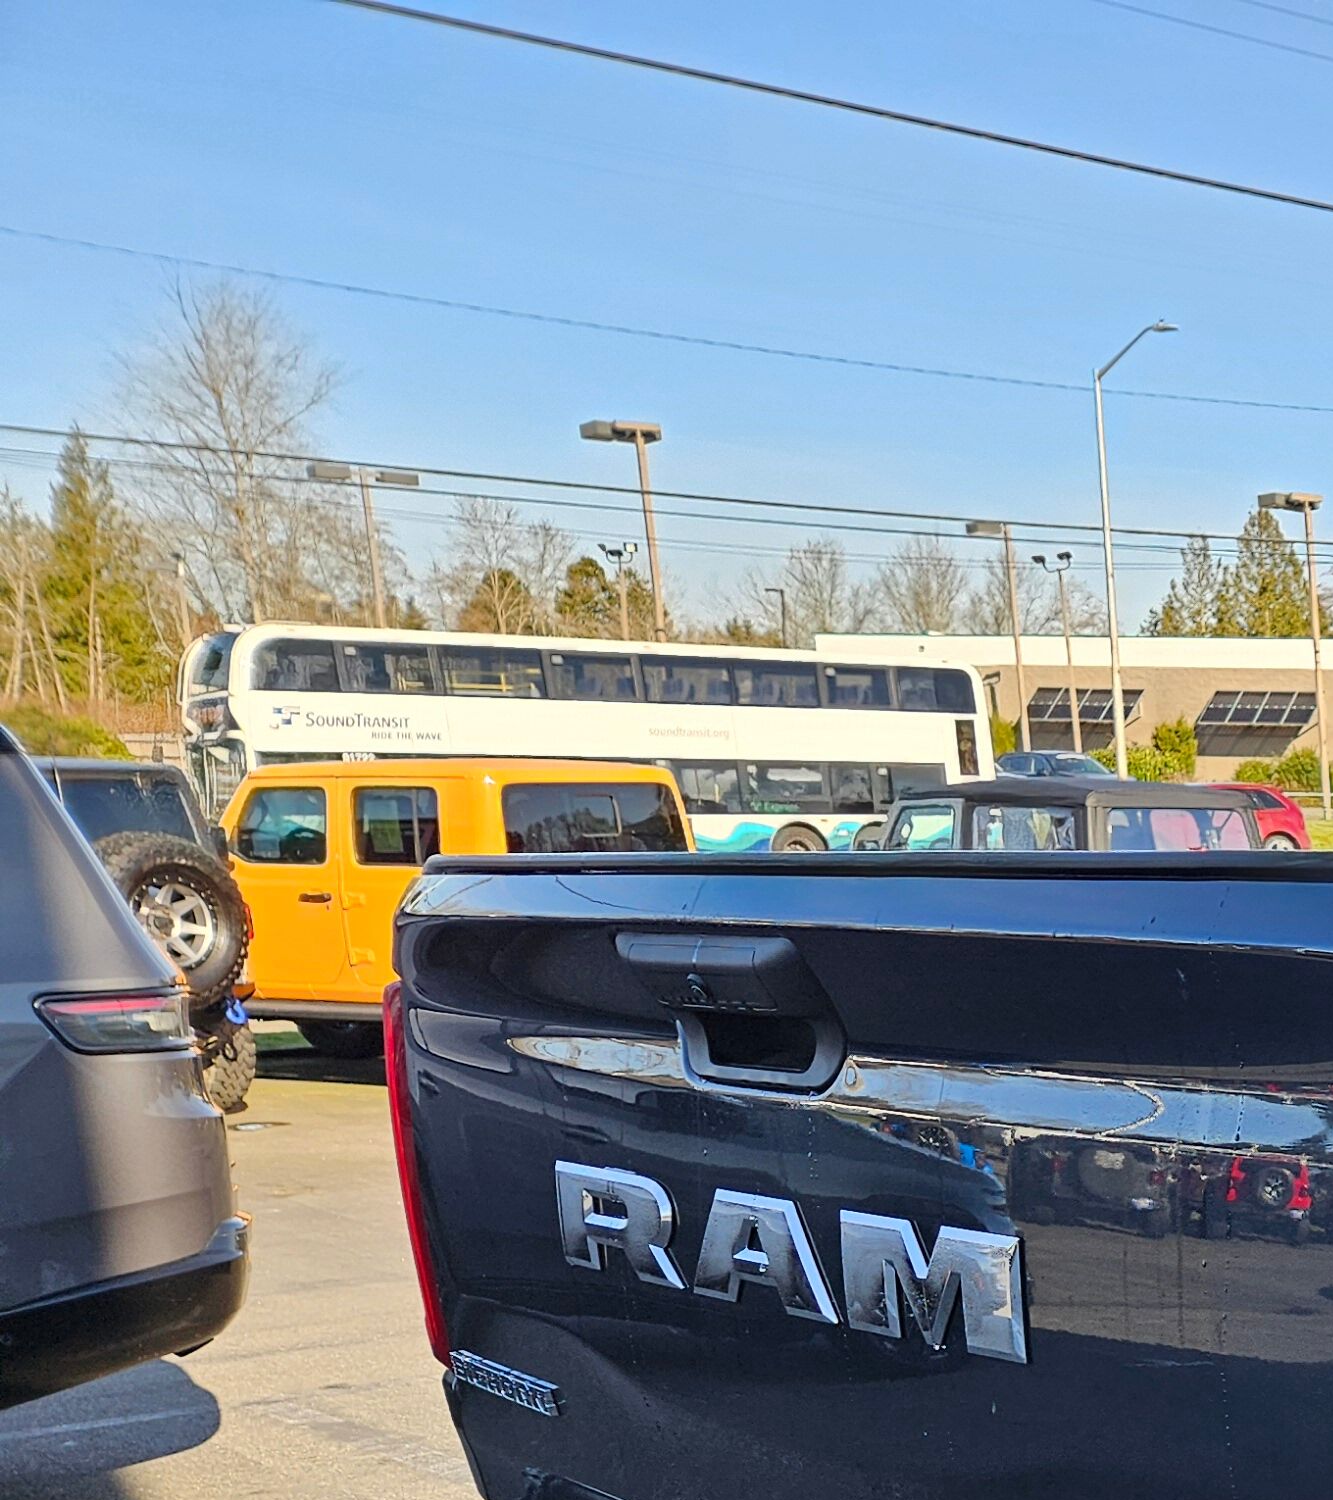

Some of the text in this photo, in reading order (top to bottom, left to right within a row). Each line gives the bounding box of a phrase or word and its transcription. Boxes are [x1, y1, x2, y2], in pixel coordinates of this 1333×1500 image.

[371, 731, 443, 741] RIDE THE WAVE
[649, 726, 730, 740] soundtransit.org
[555, 1160, 1029, 1364] RAM
